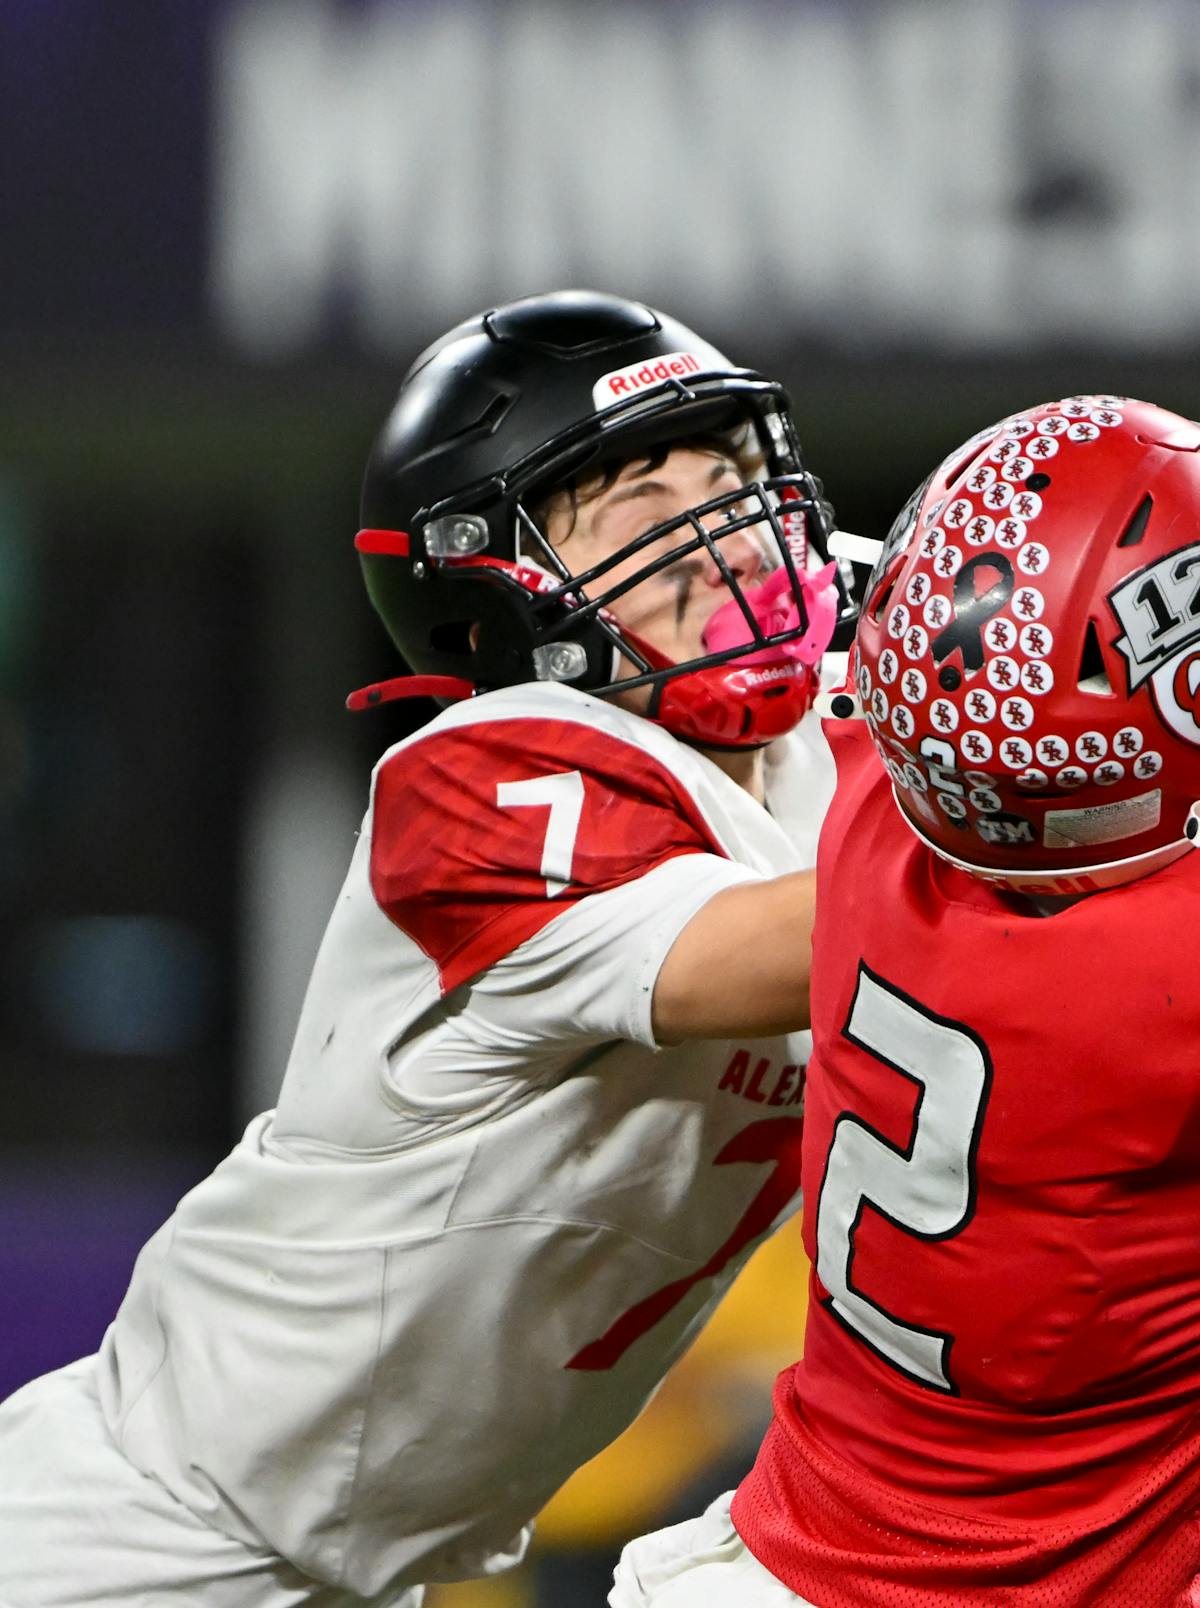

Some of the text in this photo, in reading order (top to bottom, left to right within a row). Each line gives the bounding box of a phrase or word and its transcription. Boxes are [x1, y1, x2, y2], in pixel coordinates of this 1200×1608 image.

[608, 352, 700, 396] Riddell
[744, 663, 796, 686] Riddell
[919, 734, 965, 797] 2
[496, 769, 585, 898] 7
[814, 957, 995, 1398] 2
[564, 1115, 805, 1371] 7
